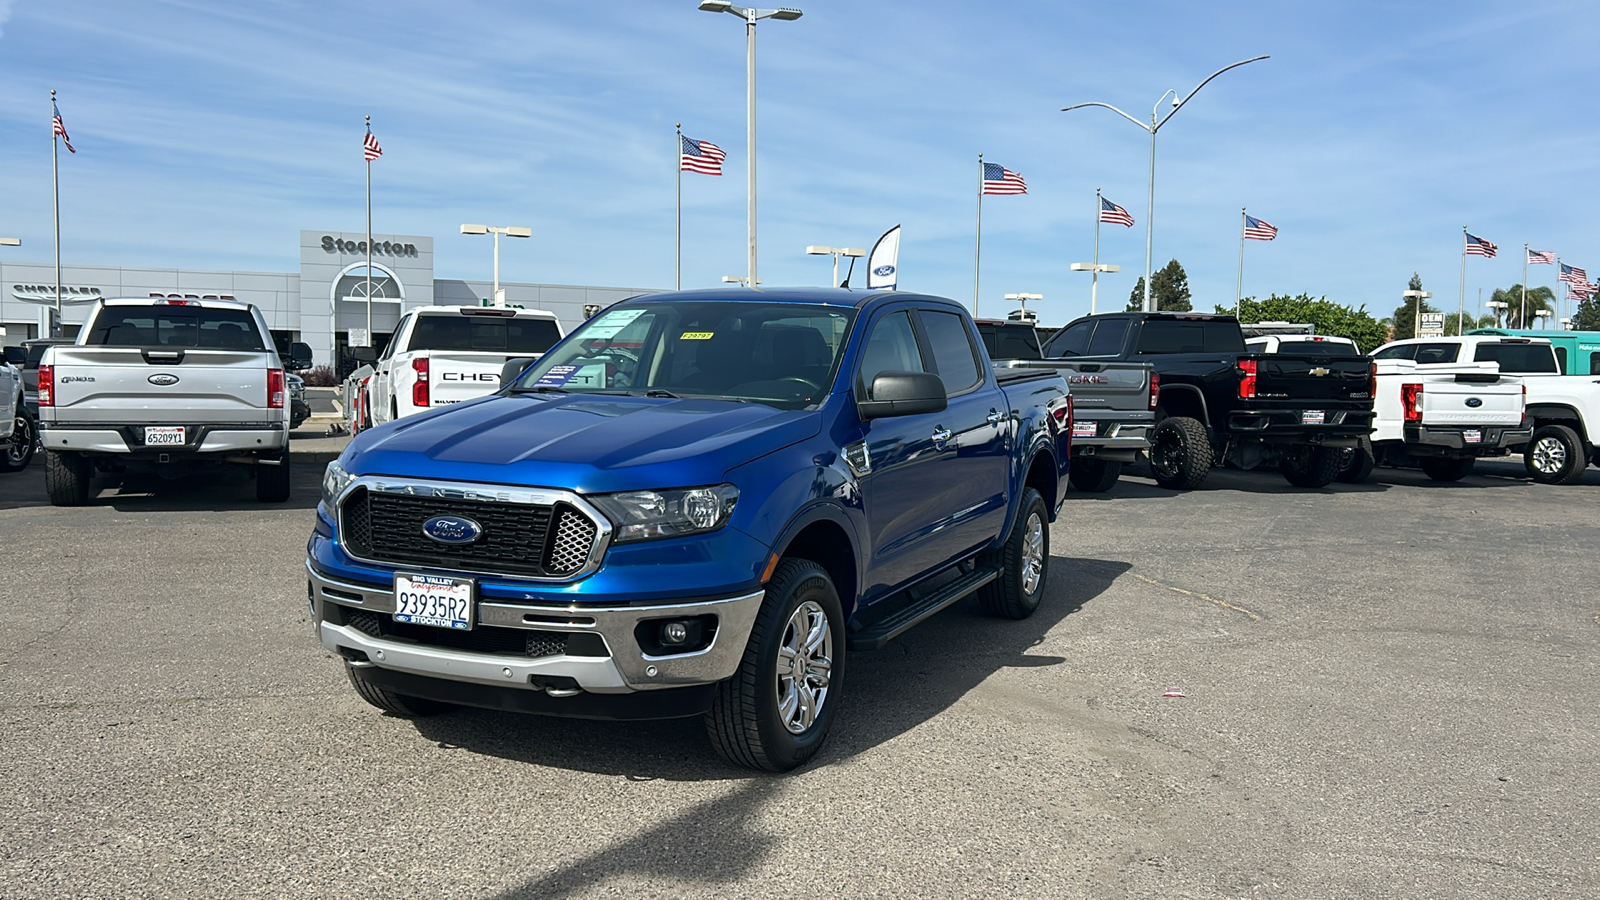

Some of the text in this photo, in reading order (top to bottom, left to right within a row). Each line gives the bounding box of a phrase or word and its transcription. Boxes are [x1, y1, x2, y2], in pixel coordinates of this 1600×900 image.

[321, 235, 416, 256] Stockton
[13, 284, 101, 295] CHRYSLER
[1421, 314, 1442, 322] OEM
[154, 376, 173, 384] Ford
[1069, 375, 1108, 385] GMC
[147, 433, 183, 443] 65209Y1
[432, 519, 465, 538] Ford
[425, 577, 454, 586] VALLEY
[410, 582, 458, 593] California
[400, 592, 467, 621] 93935R2
[410, 615, 453, 627] STOCKTON
